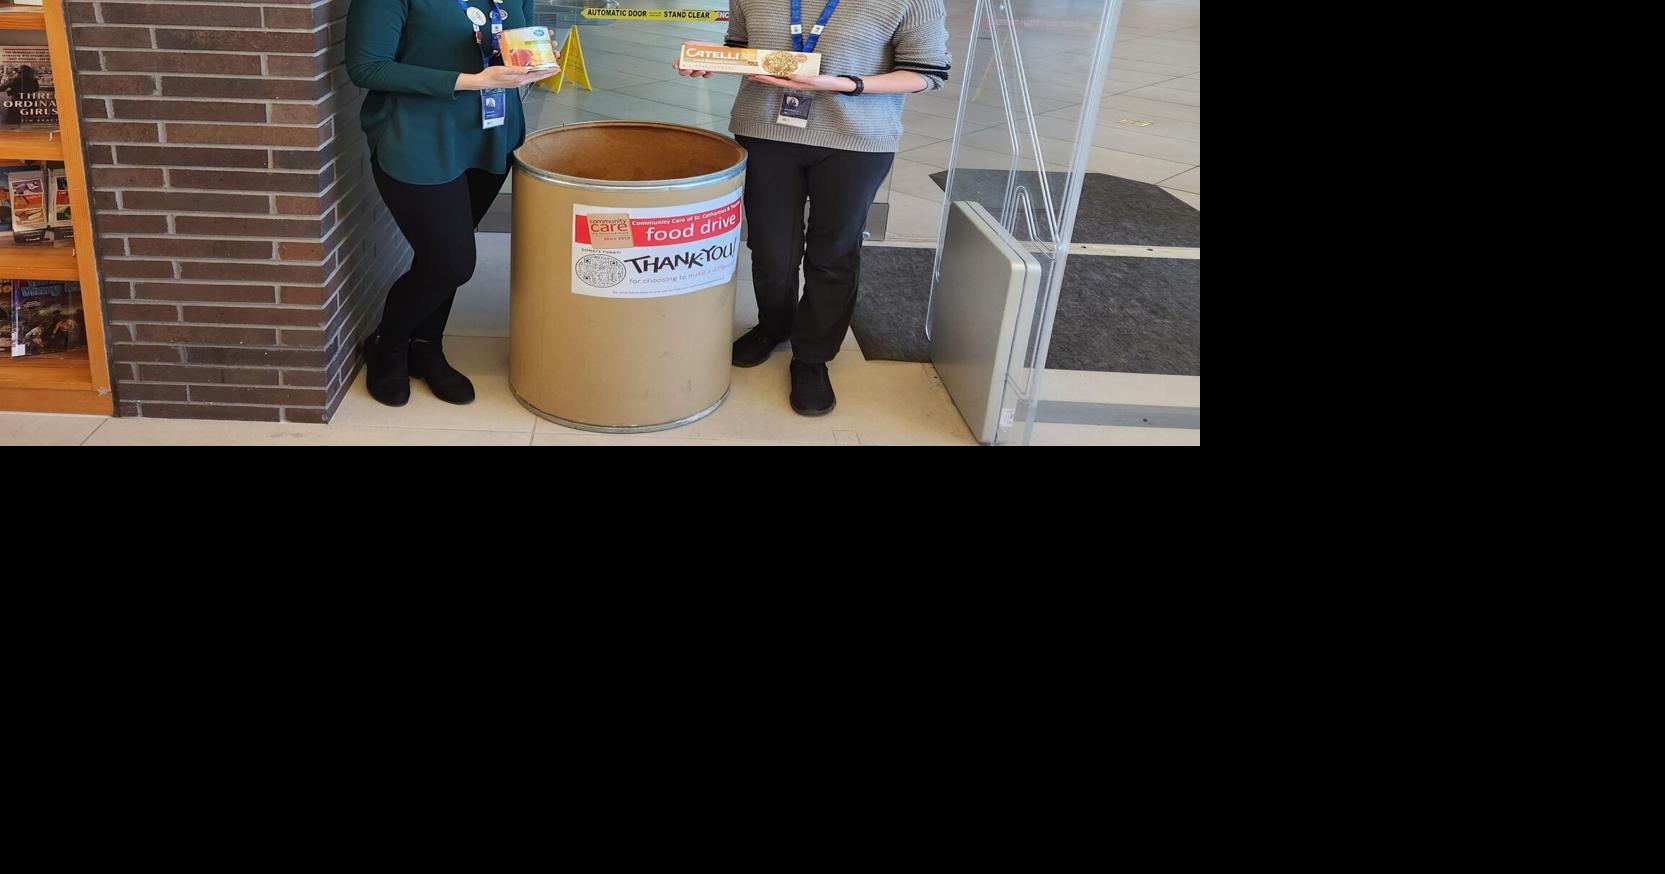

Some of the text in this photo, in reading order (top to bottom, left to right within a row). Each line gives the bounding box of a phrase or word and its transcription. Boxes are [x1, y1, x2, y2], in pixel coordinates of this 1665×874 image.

[587, 8, 627, 17] AUTOMATIC
[628, 9, 647, 17] DOOR
[663, 10, 687, 18] STAND
[687, 11, 711, 19] CLEAR
[686, 48, 739, 60] CATELLI
[3, 100, 56, 108] ORDINA
[20, 108, 58, 116] GIRLS
[590, 223, 628, 233] care
[645, 213, 736, 242] food drive
[642, 274, 678, 284] choosing
[679, 273, 688, 281] to
